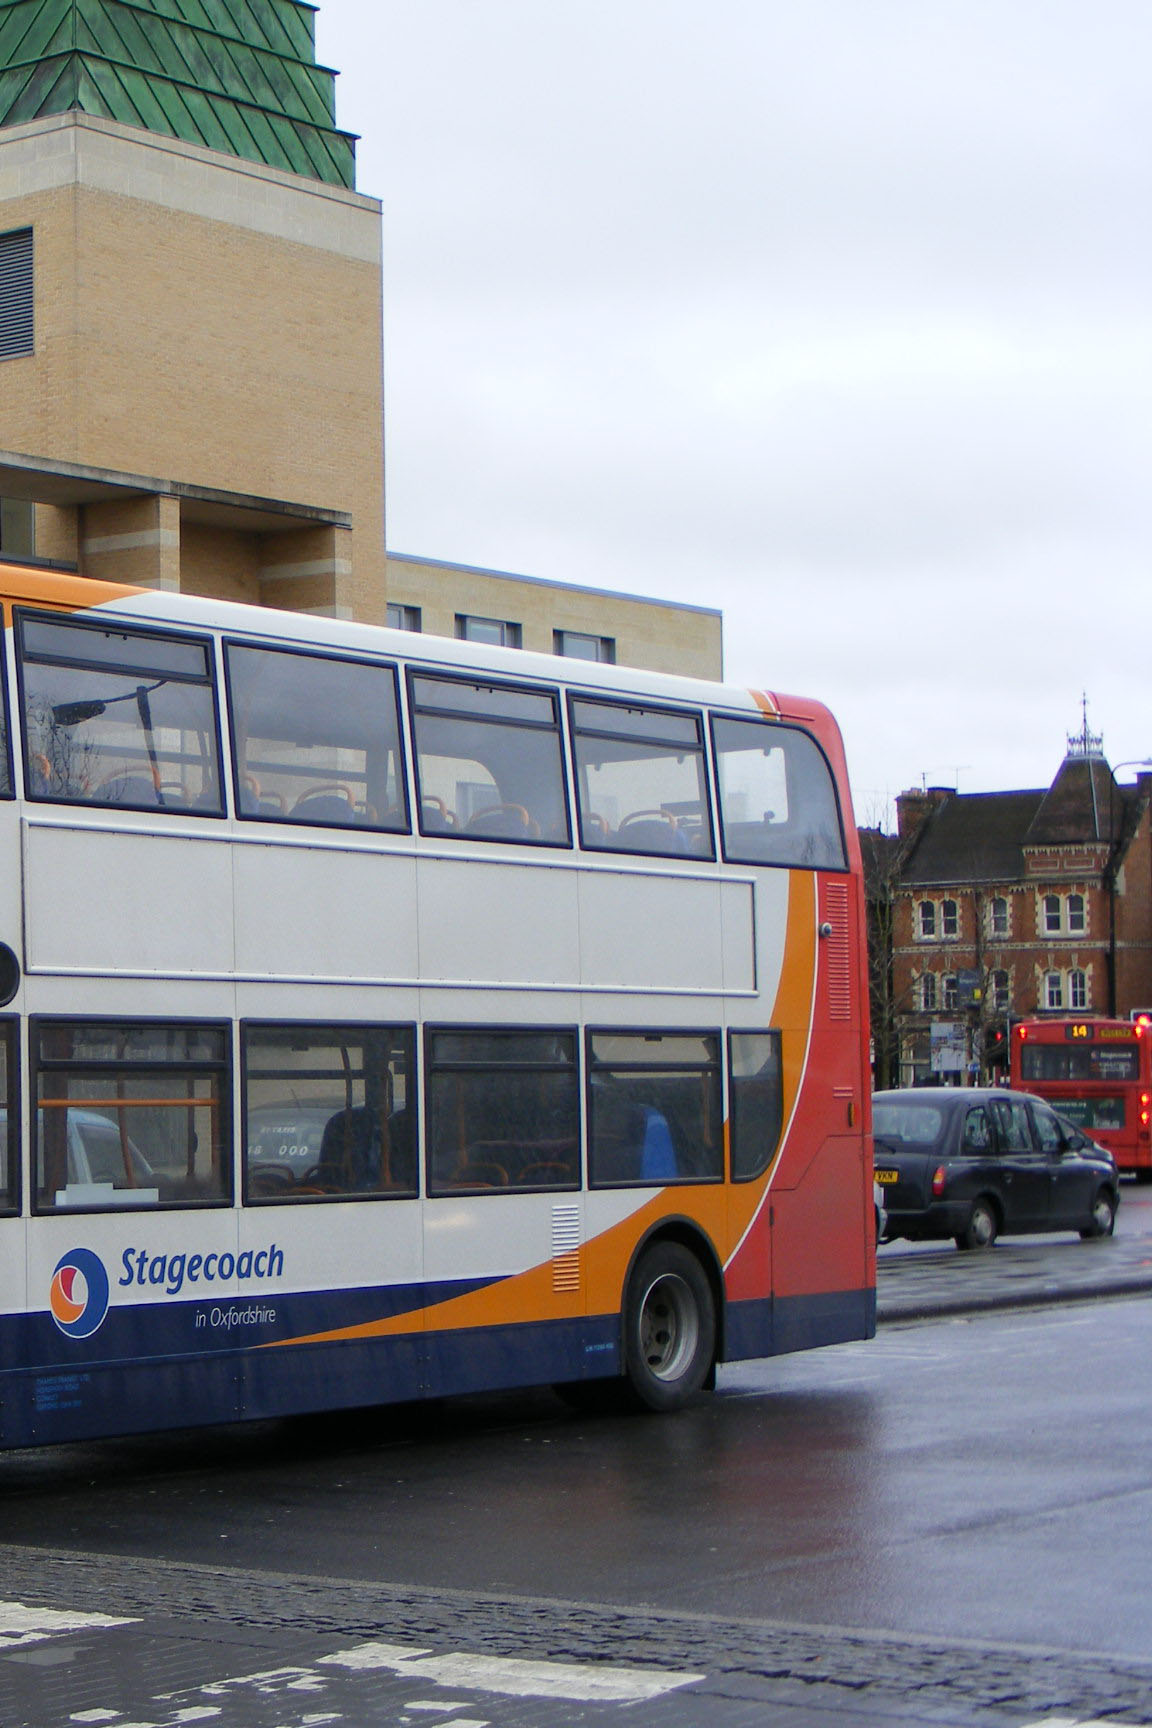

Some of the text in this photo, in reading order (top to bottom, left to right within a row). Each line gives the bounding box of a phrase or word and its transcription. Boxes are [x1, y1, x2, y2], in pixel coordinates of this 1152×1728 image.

[1072, 1024, 1087, 1037] 14
[119, 1244, 284, 1295] Stagecoach
[195, 1305, 276, 1331] in Oxfordshire
